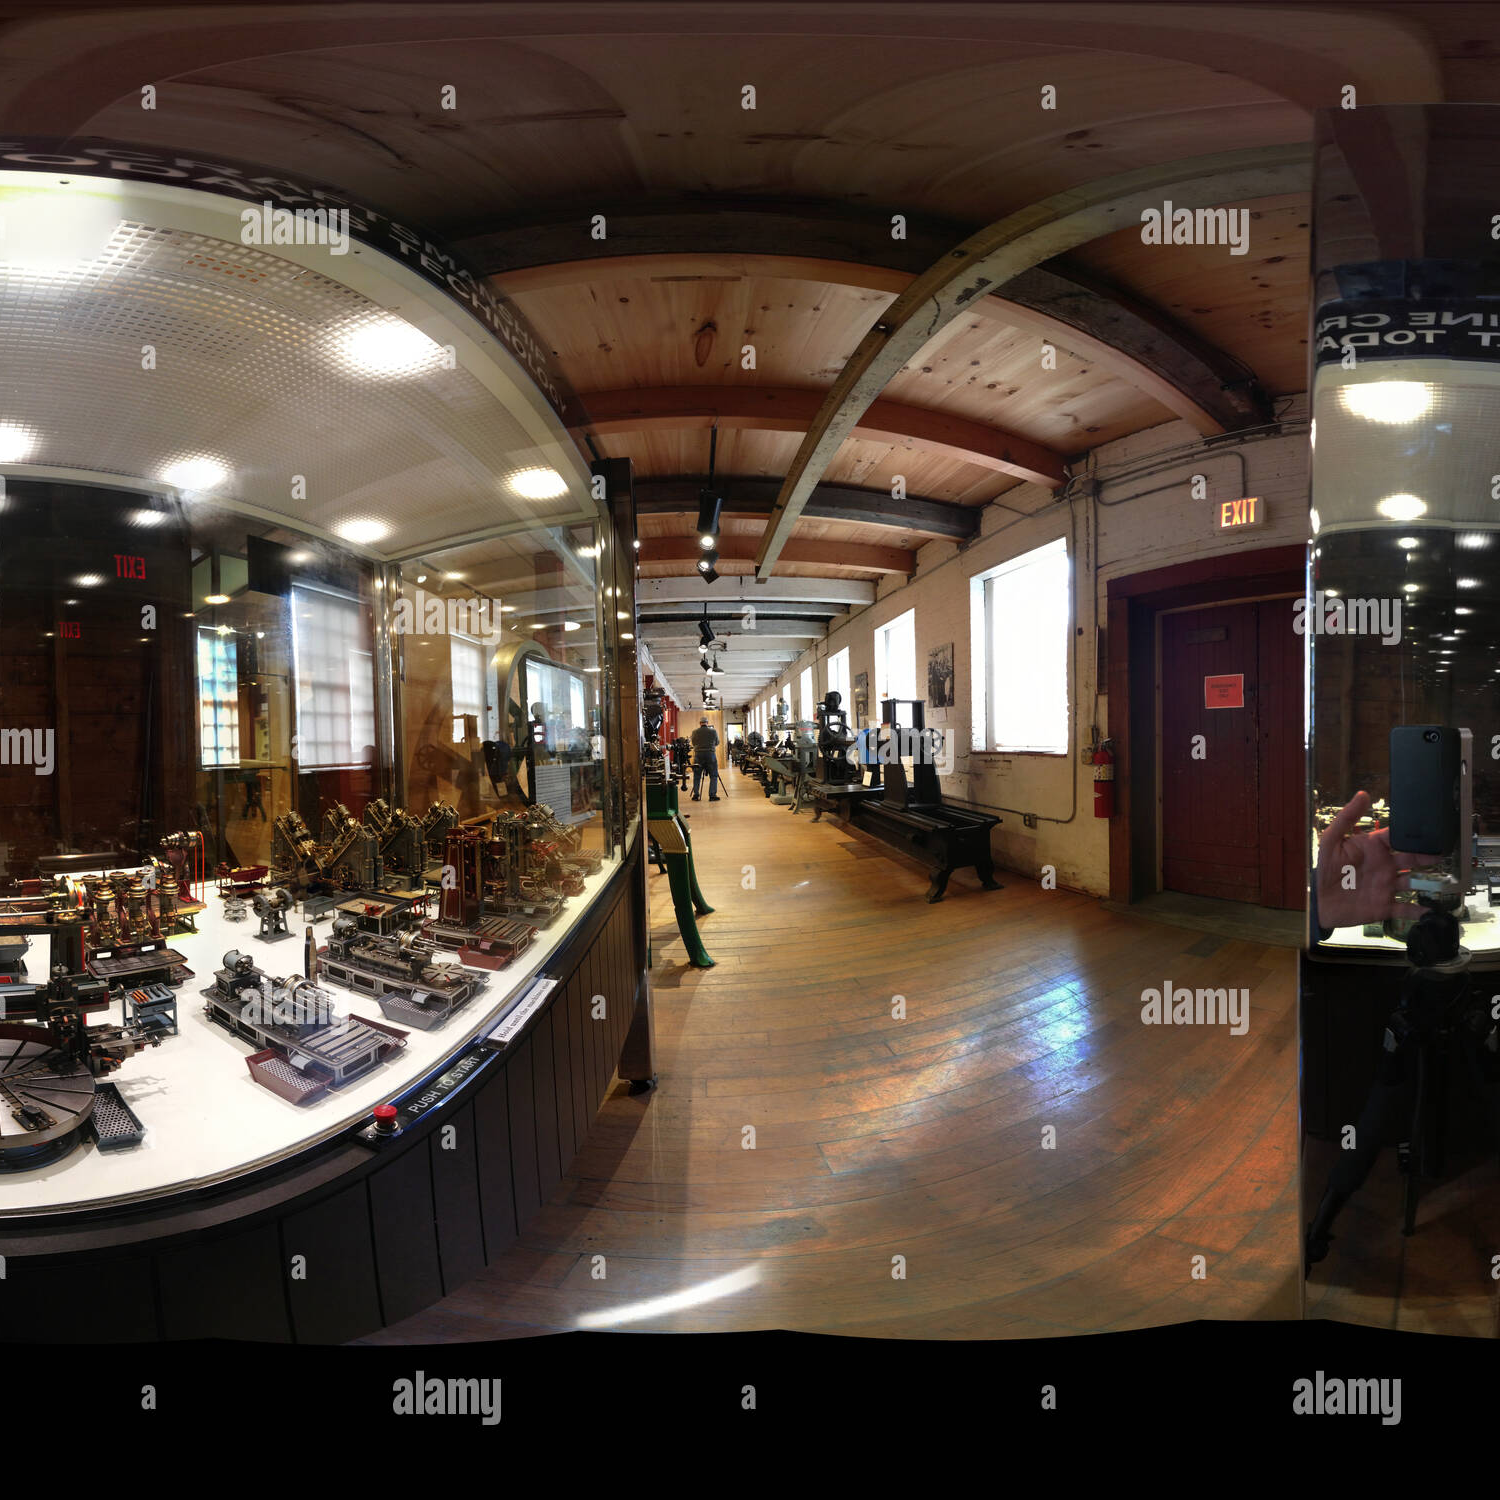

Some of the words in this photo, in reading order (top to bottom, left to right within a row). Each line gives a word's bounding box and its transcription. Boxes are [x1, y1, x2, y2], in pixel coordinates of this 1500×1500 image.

[1221, 498, 1258, 528] EXIT
[408, 1090, 441, 1113] PUSH
[438, 1079, 453, 1091] TO
[451, 1055, 480, 1079] START
